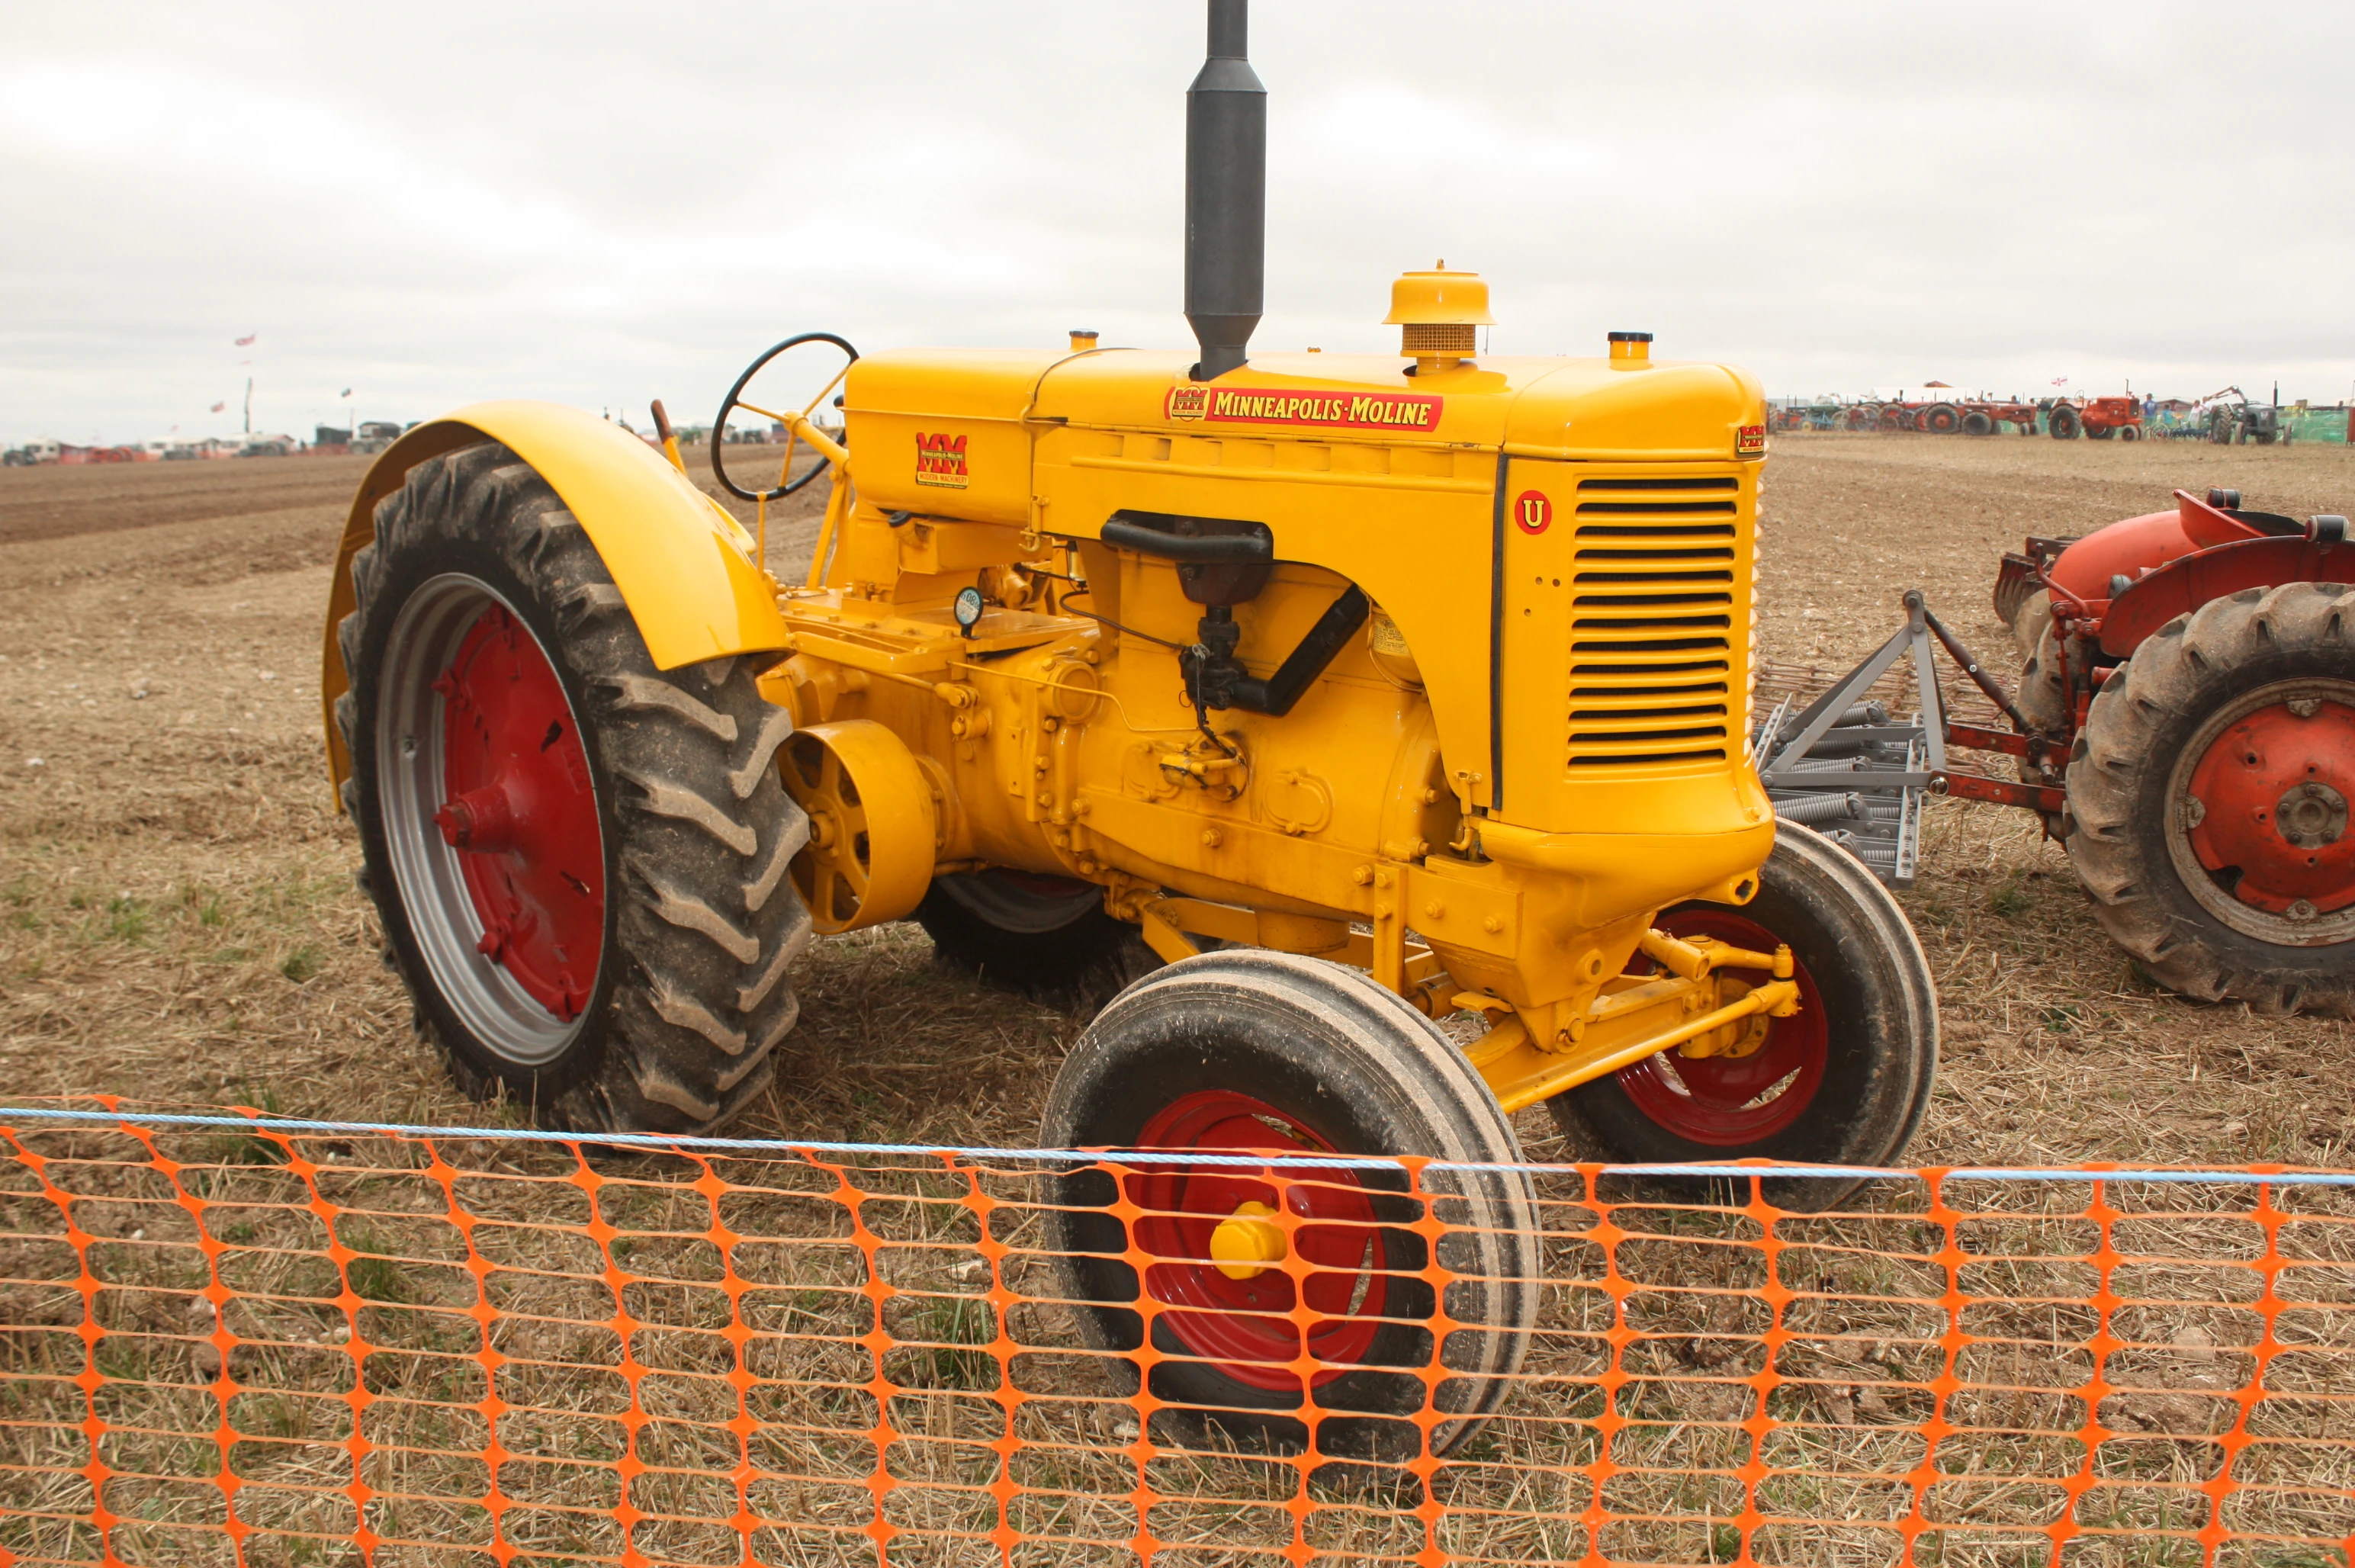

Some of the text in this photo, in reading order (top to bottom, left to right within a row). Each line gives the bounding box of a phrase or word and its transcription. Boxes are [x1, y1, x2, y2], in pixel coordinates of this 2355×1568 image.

[917, 432, 967, 475] MM
[940, 474, 967, 484] MACHINERY
[1522, 500, 1544, 527] U
